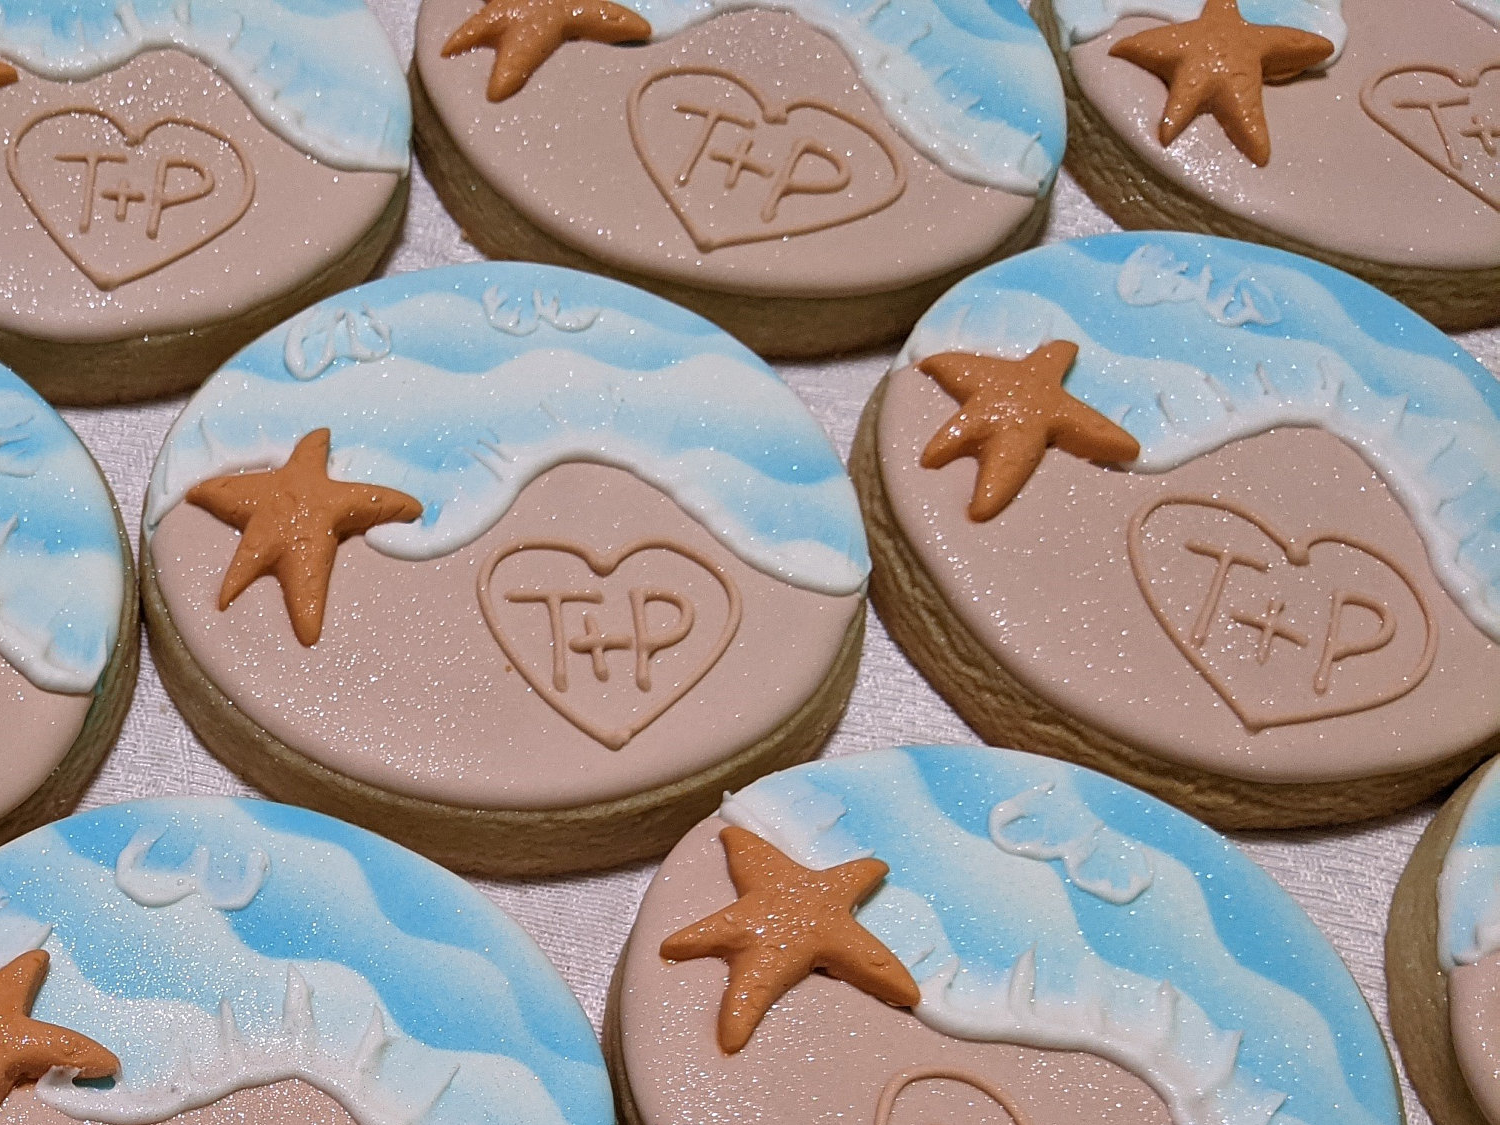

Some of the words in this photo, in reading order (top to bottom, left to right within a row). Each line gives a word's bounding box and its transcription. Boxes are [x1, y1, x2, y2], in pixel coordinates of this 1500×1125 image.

[55, 150, 214, 239] T+P
[675, 103, 851, 222] T+P
[504, 587, 695, 692] T+P
[1184, 539, 1396, 695] T+P
